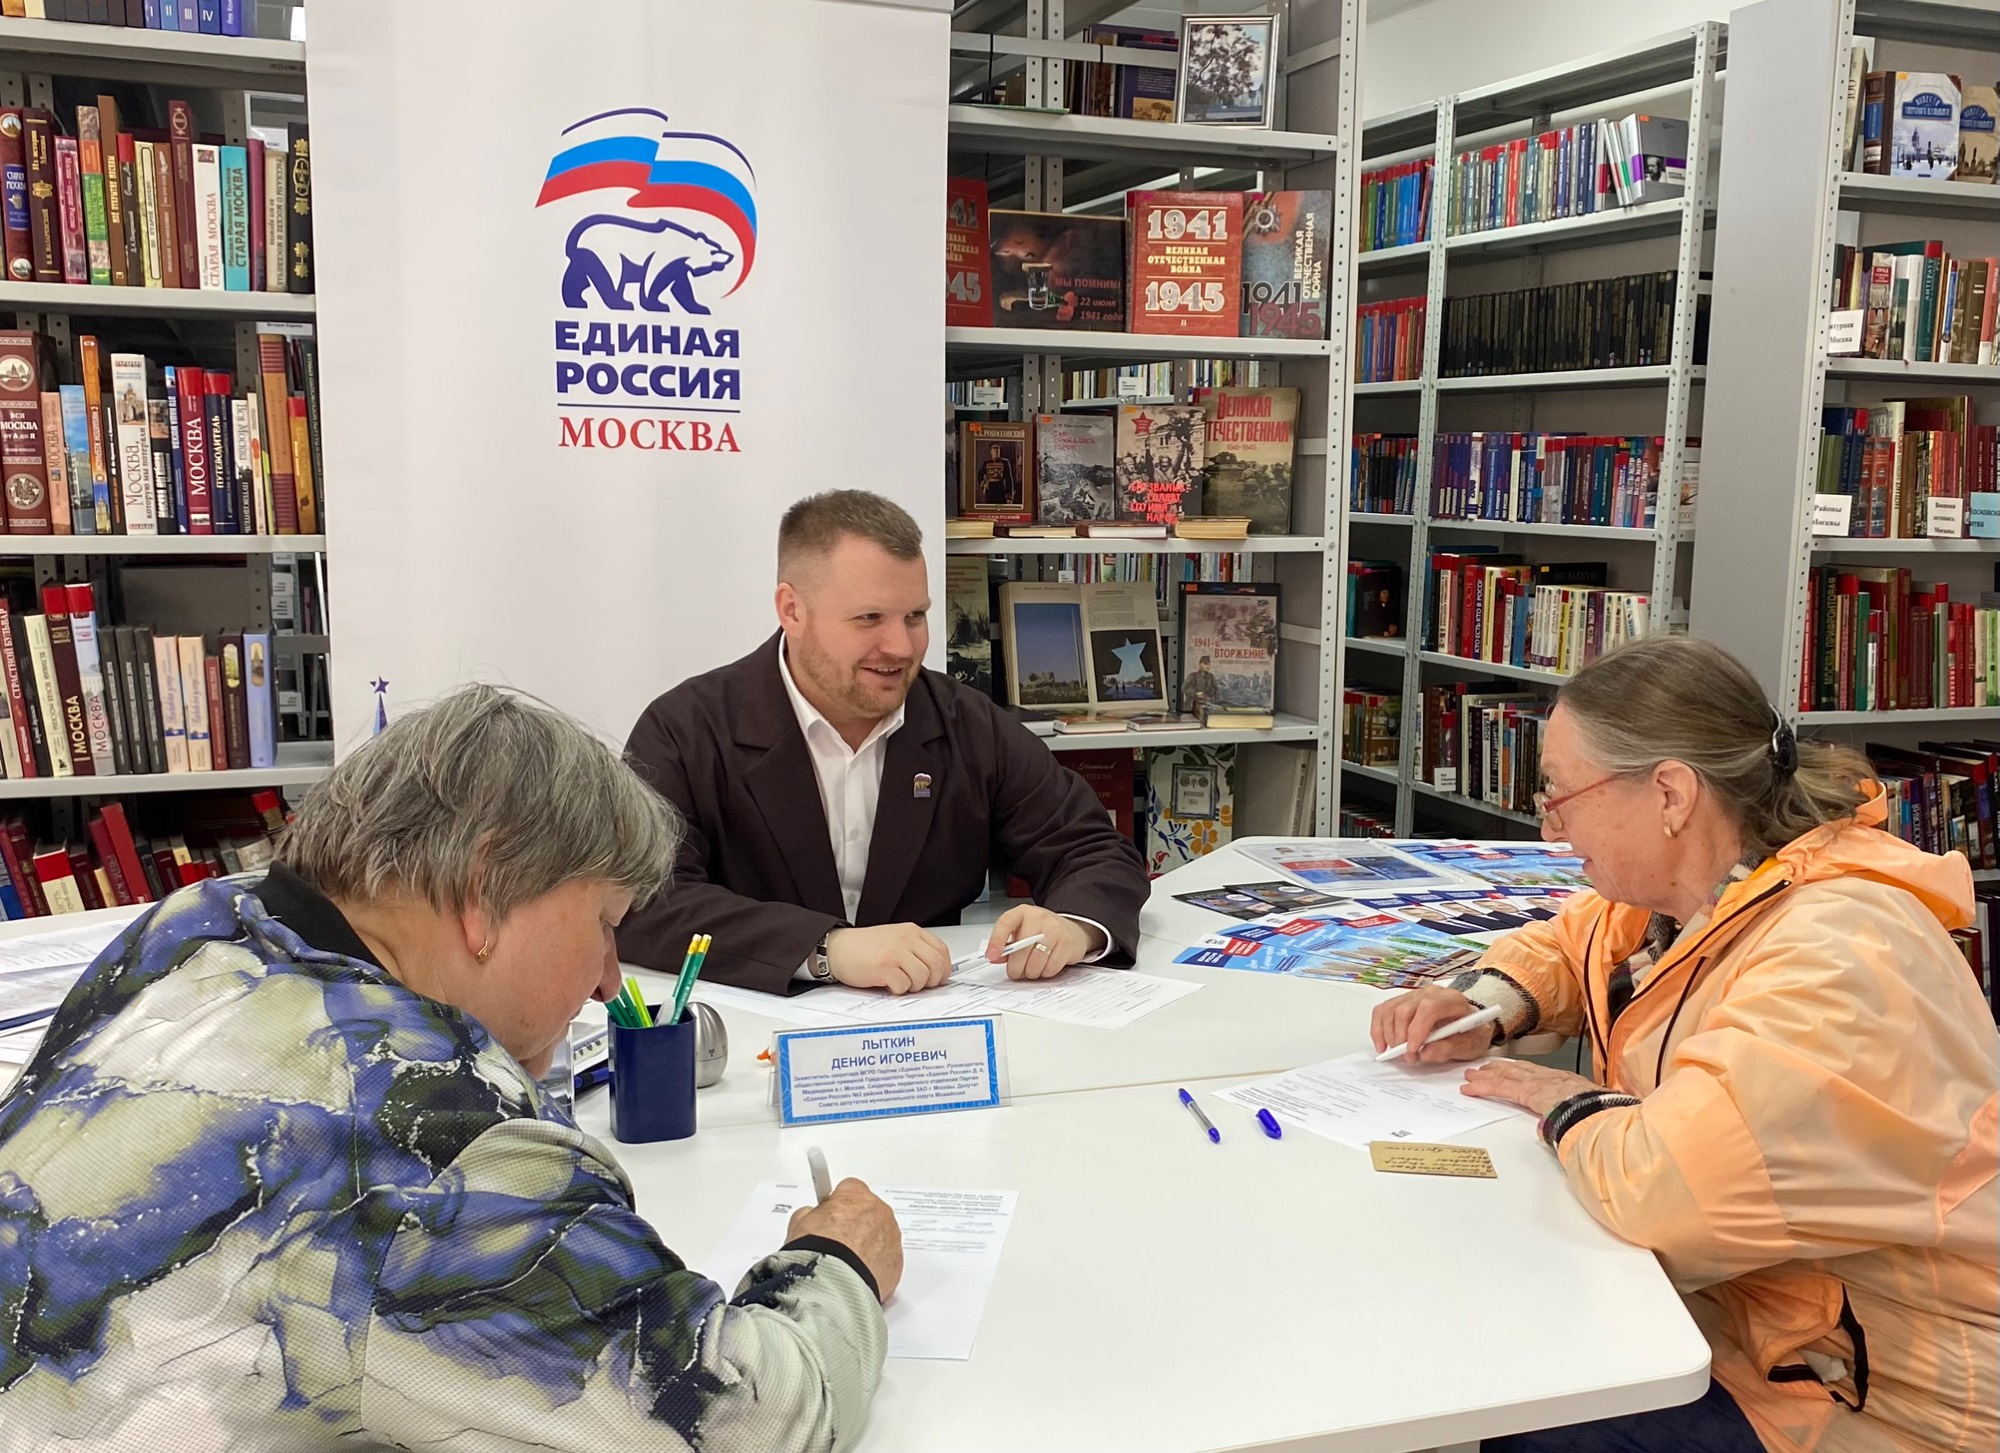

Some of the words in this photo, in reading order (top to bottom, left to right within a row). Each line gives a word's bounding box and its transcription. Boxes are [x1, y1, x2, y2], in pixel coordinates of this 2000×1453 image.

[232, 167, 244, 217] МОСКВА
[206, 192, 218, 239] МОСКВА
[1147, 209, 1228, 240] 1941
[234, 219, 247, 268] СТАРАЯ
[1147, 255, 1226, 266] ОТЕЧЕСТВЕННАЯ
[1165, 246, 1208, 256] ВЕЛИКАЯ
[1294, 230, 1304, 281] ВЕЛИКАЯ
[1303, 212, 1315, 300] ОТЕЧЕСТВЕННАЯ
[208, 245, 220, 287] СТАРАЯ
[1055, 278, 1071, 288] МЫ
[1171, 262, 1202, 274] ВОЙНА
[1312, 260, 1321, 299] ВОЙНА
[1080, 298, 1094, 307] 22
[1145, 282, 1225, 311] 1945
[1080, 311, 1101, 320] 1941
[1249, 302, 1321, 337] 1945
[555, 320, 740, 358] ЕДИНАЯ
[556, 361, 741, 400] РОССИЯ
[1217, 392, 1272, 419] ВЕЛИКАЯ
[0, 421, 38, 430] МОСКВА
[558, 417, 742, 452] МОСКВА
[1206, 421, 1290, 443] ТЕЧЕСТВЕННАЯ
[187, 417, 206, 496] МОСКВА
[212, 415, 224, 488] ПУТЕВОДИТЕЛЬ
[124, 441, 143, 507] Москва,
[1814, 505, 1842, 513] Районы
[1970, 520, 1984, 529] итва
[0, 608, 13, 647] БУЛЬВАР
[1214, 648, 1266, 660] ВТОРЖЕНИЕ
[1823, 649, 1835, 685] МОСКВА
[3, 647, 21, 699] СТРАСТНОЙ
[66, 695, 87, 754] МОСКВА
[89, 694, 108, 752] МОСКВА
[831, 1054, 877, 1070] ДЕНИС
[879, 1049, 948, 1066] ИГОРЕВИЧ
[862, 1036, 916, 1051] ЛЫТКИН
